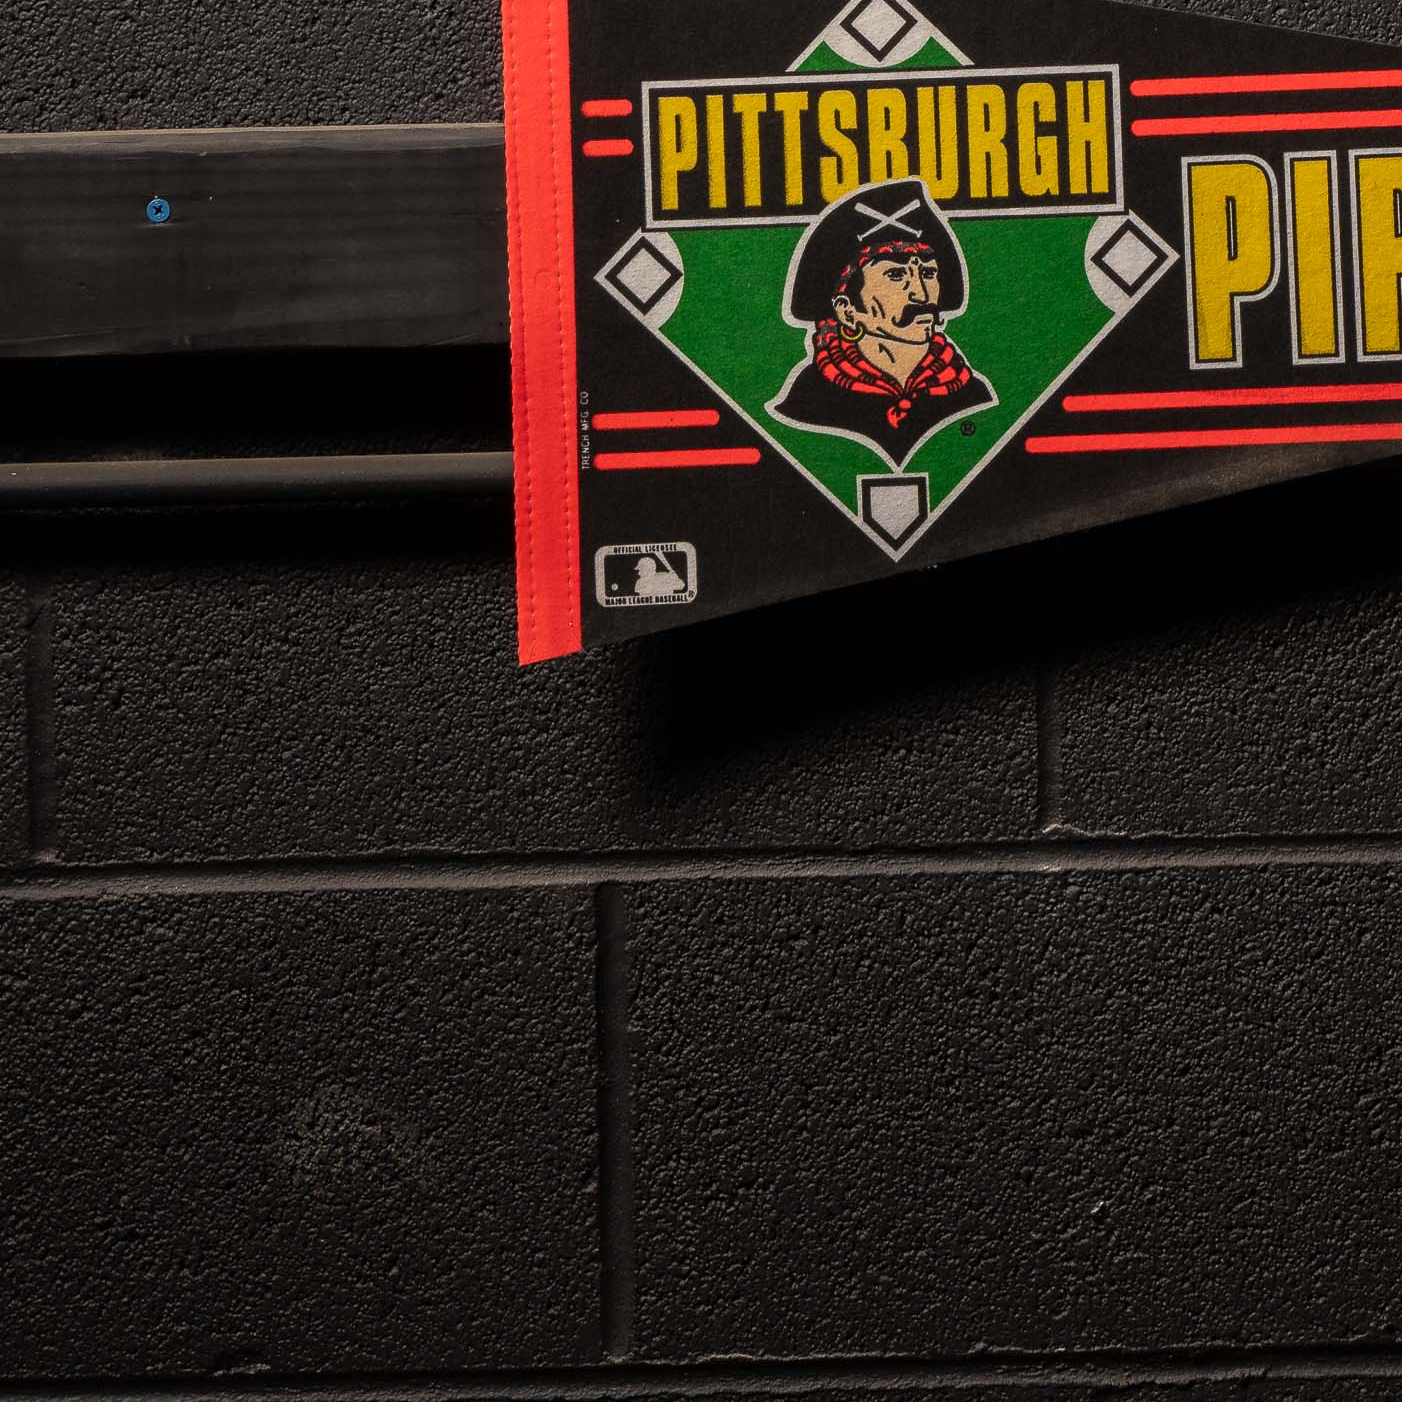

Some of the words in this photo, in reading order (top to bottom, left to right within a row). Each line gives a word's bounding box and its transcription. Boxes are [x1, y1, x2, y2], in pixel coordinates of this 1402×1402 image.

[657, 79, 1110, 211] PITTSBURGH
[580, 411, 590, 431] MFG
[581, 434, 591, 470] TRENCH
[613, 545, 643, 554] OFFICIAL
[605, 596, 628, 606] MAJOR
[628, 595, 654, 605] LEAGUE
[654, 594, 689, 604] BASEBALL
